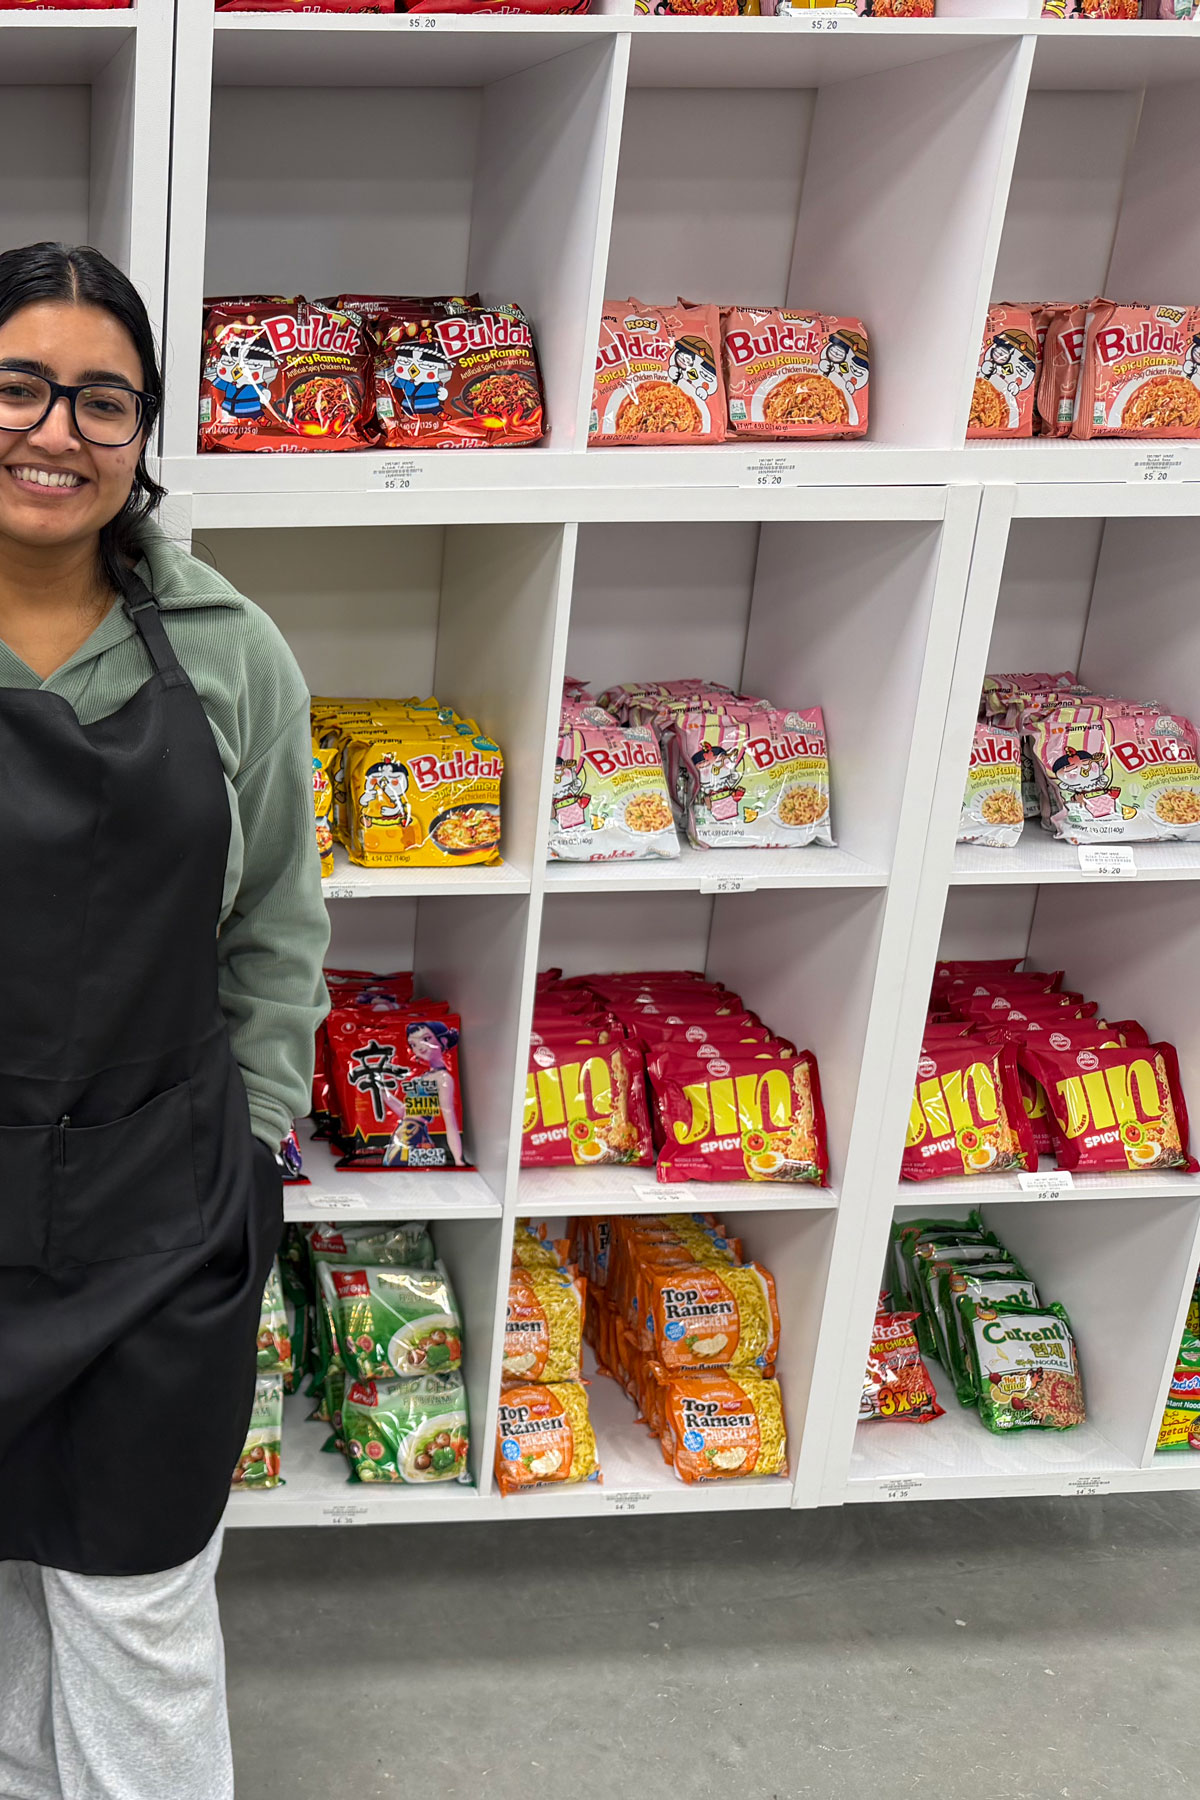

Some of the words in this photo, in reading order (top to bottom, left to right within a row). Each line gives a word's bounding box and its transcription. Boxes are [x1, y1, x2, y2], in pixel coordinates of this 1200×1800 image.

[409, 18, 436, 28] $5.20
[811, 20, 838, 30] $5.20
[625, 319, 658, 331] ROSÉ
[261, 315, 360, 356] Buldak
[435, 315, 532, 359] Buldak
[726, 324, 821, 367] Buldak
[1096, 322, 1185, 366] Buldak
[286, 355, 313, 367] Spicy
[313, 353, 350, 364] Ramen
[459, 354, 489, 368] Spicy
[490, 349, 530, 360] Ramen
[745, 358, 776, 375] Spicy
[776, 355, 813, 366] Ramen
[286, 366, 306, 377] Artificial
[306, 365, 321, 373] Spicy
[461, 367, 481, 380] Artificial
[482, 364, 497, 373] Spicy
[781, 366, 802, 374] Chicken
[1113, 361, 1142, 375] Spicy
[1144, 357, 1178, 366] Ramen
[596, 370, 627, 384] Spicy
[629, 363, 662, 374] Ramen
[633, 373, 653, 383] Chicken
[653, 372, 668, 380] Flavor
[238, 426, 251, 435] (125
[757, 476, 782, 485] $5.20
[1143, 472, 1168, 481] $5.20
[384, 480, 410, 489] $5.20
[1065, 724, 1103, 732] Samyang
[408, 750, 503, 793] Buldak
[769, 766, 794, 779] Spicy
[394, 855, 411, 863] (140g)
[1098, 866, 1121, 875] $5.20
[717, 883, 741, 891] $5.20
[348, 1039, 411, 1122] 辛
[402, 1079, 437, 1094] 라면
[405, 1097, 439, 1108] SHIN
[405, 1108, 441, 1117] RAMYUN
[531, 1127, 568, 1145] SPICY
[1084, 1131, 1119, 1148] SPICY
[408, 1148, 445, 1157] KPOP
[700, 1138, 740, 1153] SPICY
[921, 1138, 956, 1158] SPICY
[1038, 1191, 1060, 1200] $5.00
[661, 1289, 698, 1305] Top
[666, 1302, 733, 1319] Ramen
[983, 1322, 1065, 1344] Current
[1035, 1360, 1069, 1368] NOODLES
[682, 1399, 719, 1416] Top
[880, 1387, 911, 1415] 3x
[500, 1405, 529, 1421] Top
[684, 1413, 752, 1427] Ramen
[501, 1419, 563, 1437] Ramen
[705, 1429, 747, 1440] CHICKEN
